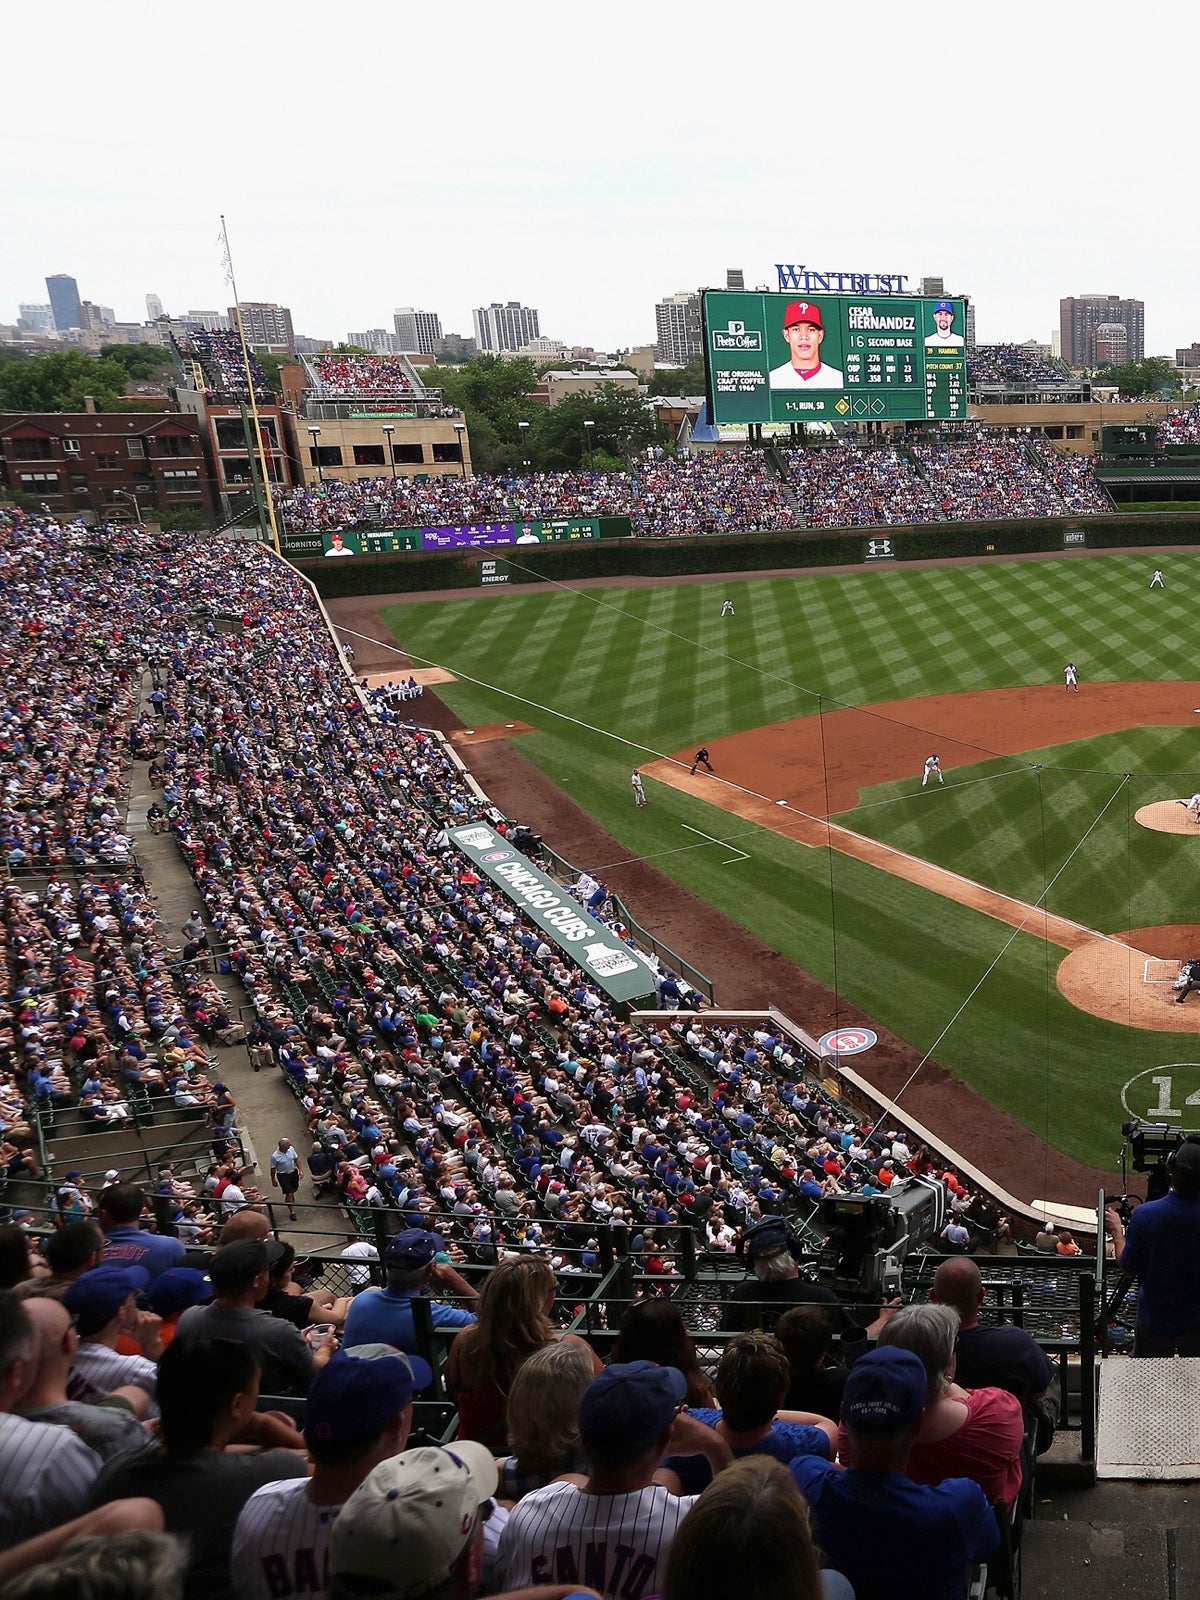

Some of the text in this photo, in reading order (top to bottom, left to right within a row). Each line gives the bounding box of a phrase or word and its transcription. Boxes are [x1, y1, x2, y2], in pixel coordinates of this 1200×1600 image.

[774, 264, 908, 293] WINTRUST
[849, 306, 873, 317] CESAR
[849, 316, 916, 330] HERNANDEZ
[735, 336, 758, 348] Coffee
[850, 335, 865, 348] 16
[868, 338, 913, 348] SECOND BASE
[847, 354, 860, 362] AVG
[866, 354, 881, 362] .276
[847, 364, 861, 372] OBP
[867, 364, 881, 373] .360
[886, 365, 896, 373] RBI
[904, 365, 912, 373] 23
[848, 375, 860, 383] SLG
[867, 375, 881, 383] .358
[886, 375, 891, 383] R
[904, 375, 912, 383] 35
[815, 402, 825, 410] SB
[285, 540, 322, 549] HORNITOS
[482, 575, 509, 583] ENERGY
[494, 862, 596, 941] CHICAGO CUBS
